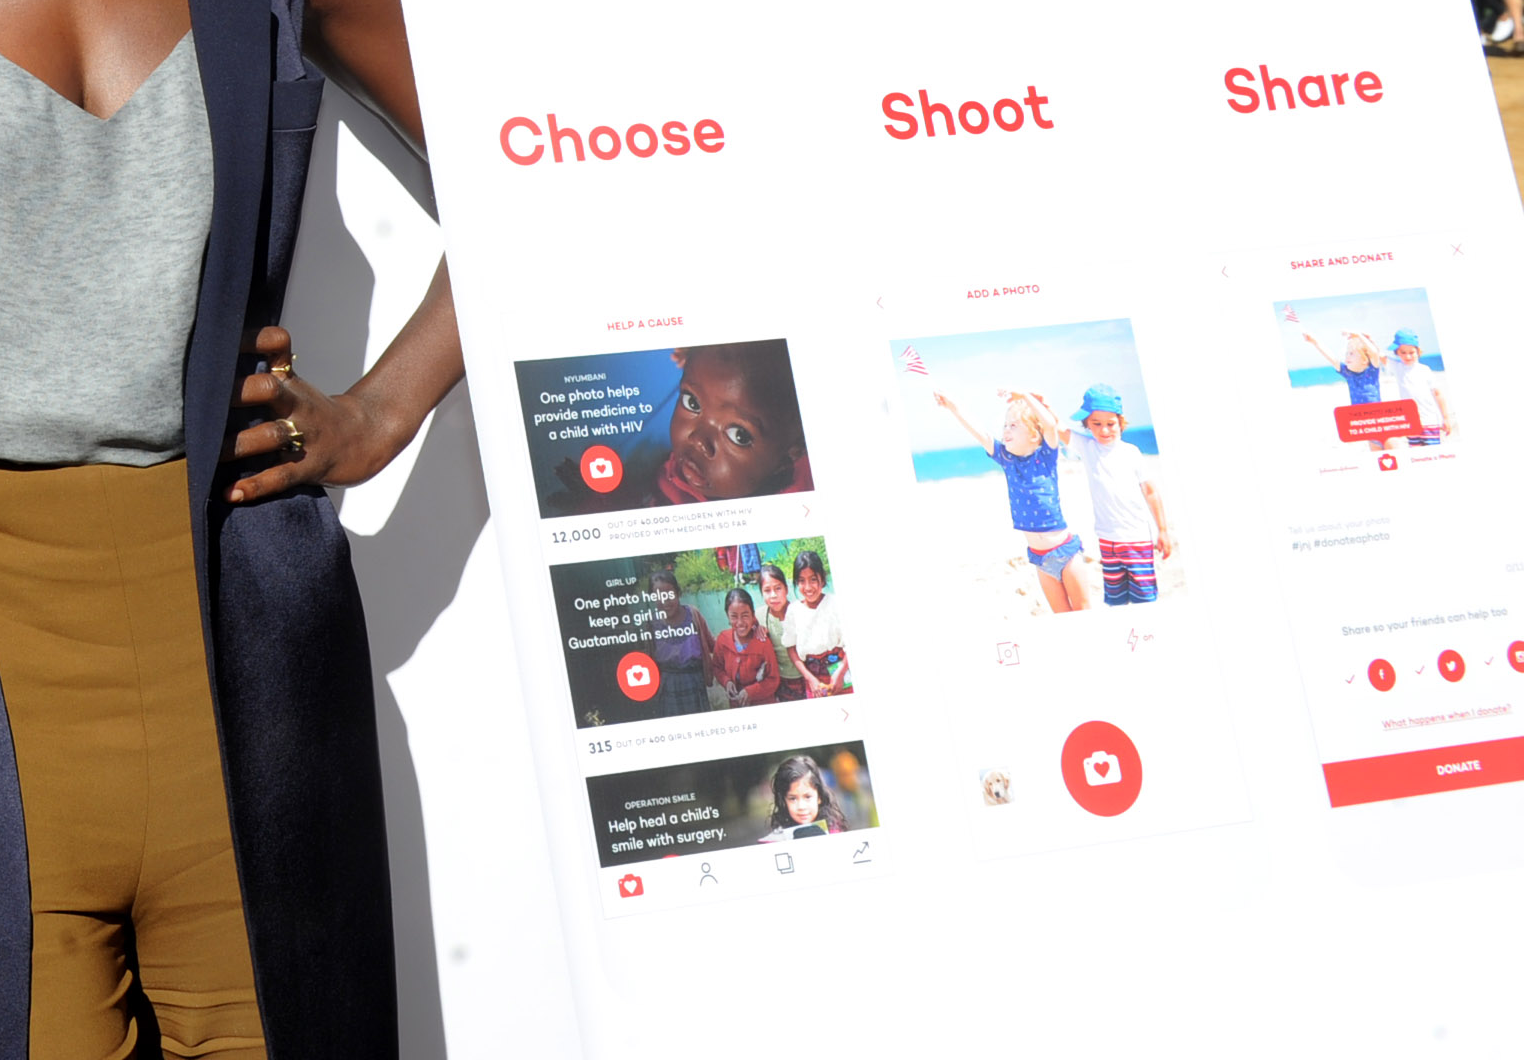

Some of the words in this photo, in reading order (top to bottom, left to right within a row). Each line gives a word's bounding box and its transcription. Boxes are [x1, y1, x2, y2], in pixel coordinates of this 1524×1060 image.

[1223, 63, 1385, 115] Share
[881, 85, 1055, 140] Shoot
[499, 112, 726, 166] Choose
[1290, 258, 1325, 270] SHARE
[1328, 256, 1350, 266] AND
[1352, 252, 1394, 264] DONATE
[966, 288, 990, 299] ADD
[992, 288, 1001, 297] A
[1002, 284, 1041, 296] PHOTO
[607, 319, 636, 331] HELP
[638, 320, 646, 328] A
[648, 316, 684, 327] CAUSE
[564, 372, 606, 384] NYUMBANI
[540, 391, 566, 404] One
[568, 387, 605, 407] photo
[607, 384, 640, 401] helps
[534, 406, 578, 426] provide
[581, 403, 636, 420] medicine
[639, 402, 653, 414] to
[548, 429, 558, 440] a
[560, 424, 589, 439] child
[591, 421, 619, 436] with
[621, 419, 643, 433] HIV
[607, 521, 624, 529] OUT
[627, 519, 638, 527] OF
[672, 511, 713, 523] CHILDREN
[716, 509, 737, 517] WITH
[739, 507, 753, 515] HIV
[552, 526, 602, 544] 12,000
[609, 530, 651, 540] PROVIDED
[654, 528, 675, 536] WITH
[677, 523, 716, 533] MEDICINE
[718, 521, 730, 529] SO
[1292, 540, 1312, 552] #jnj
[1314, 532, 1390, 549] #donateaphoto
[605, 578, 624, 588] GIRL
[625, 576, 637, 586] UP
[574, 596, 601, 610] One
[603, 592, 640, 612] photo
[642, 588, 676, 606] helps
[588, 614, 619, 631] keep
[621, 615, 631, 626] a
[633, 609, 654, 626] girl
[655, 608, 667, 621] in
[1342, 624, 1371, 636] Share
[1373, 624, 1385, 632] so
[1387, 620, 1408, 633] your
[1411, 615, 1445, 628] friends
[1447, 614, 1466, 624] can
[1468, 609, 1489, 621] help
[1491, 607, 1509, 618] too
[568, 630, 638, 650] Guatamala
[640, 628, 652, 641] in
[654, 622, 698, 640] school.
[1382, 718, 1406, 729] What
[1408, 711, 1445, 727] happens
[1448, 709, 1470, 721] when
[1477, 703, 1512, 717] donate?
[588, 739, 613, 754] 315
[616, 740, 633, 749] OUT
[636, 737, 647, 746] OF
[649, 734, 666, 744] 400
[668, 731, 692, 742] GIRLS
[694, 727, 727, 739] HELPED
[729, 725, 740, 734] SO
[742, 723, 758, 732] FAR
[1436, 760, 1481, 776] DONATE
[624, 796, 671, 810] OPERATION
[672, 792, 696, 803] SMILE
[608, 817, 637, 834] Help
[639, 813, 667, 830] heal
[669, 813, 678, 824] a
[681, 807, 720, 824] child's
[611, 837, 645, 854] smile
[647, 833, 674, 848] with
[677, 827, 727, 847] surgery.
